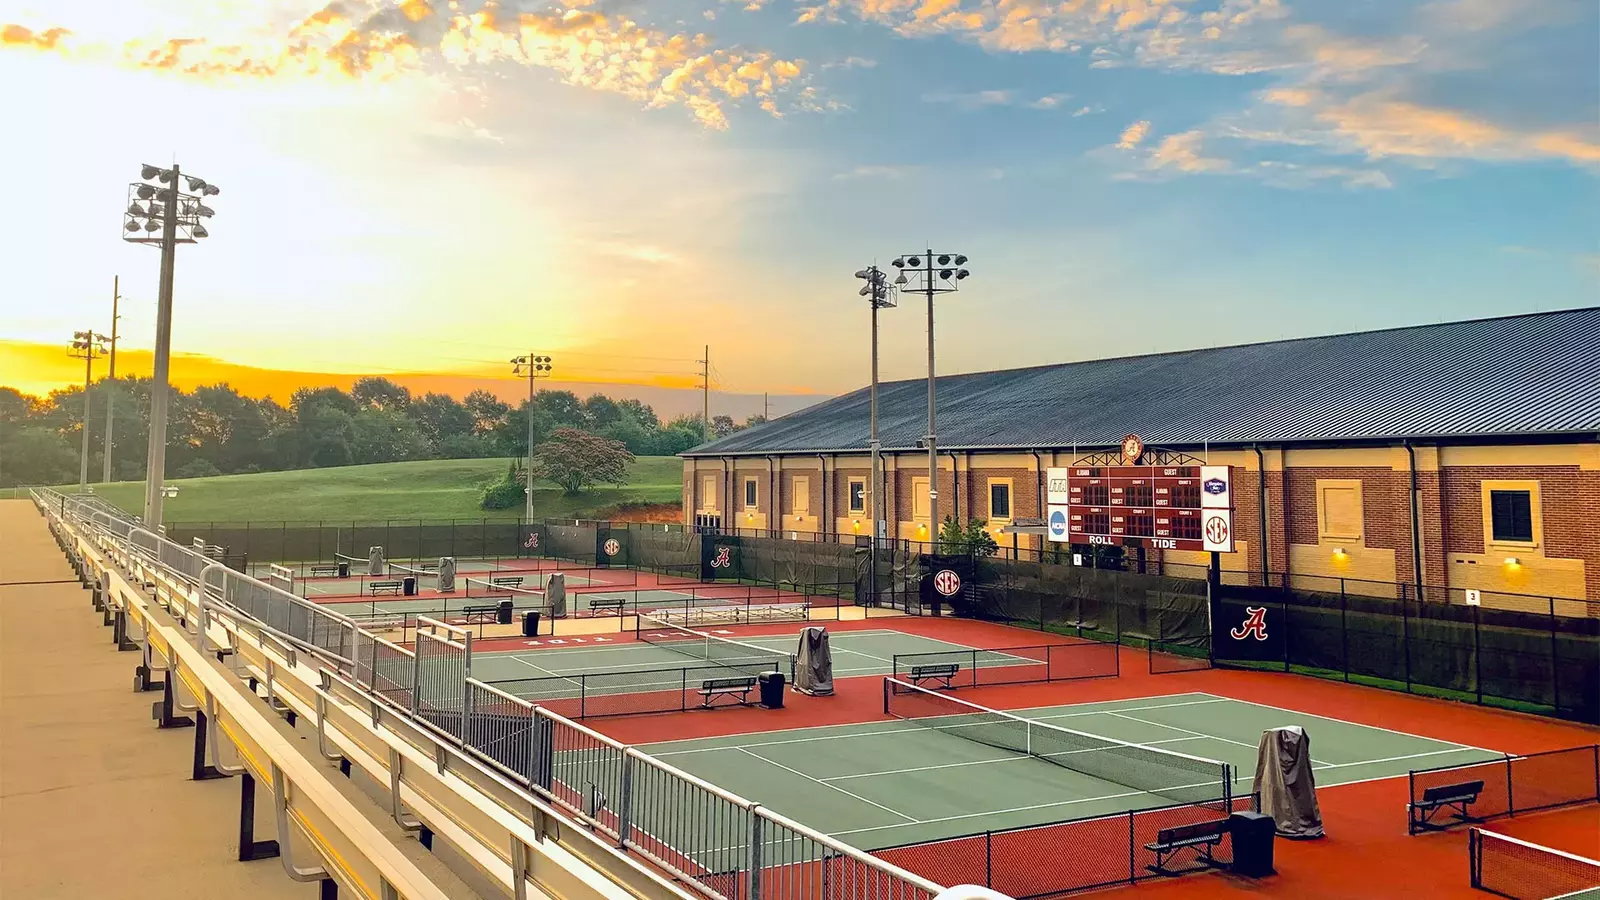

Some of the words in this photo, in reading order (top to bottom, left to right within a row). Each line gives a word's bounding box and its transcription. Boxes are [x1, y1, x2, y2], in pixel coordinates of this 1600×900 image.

[1089, 535, 1114, 545] ROLL
[1152, 539, 1177, 549] TIDE
[1206, 516, 1227, 544] SEC
[935, 570, 960, 595] SEC
[1470, 592, 1476, 601] 3
[1231, 607, 1268, 641] A
